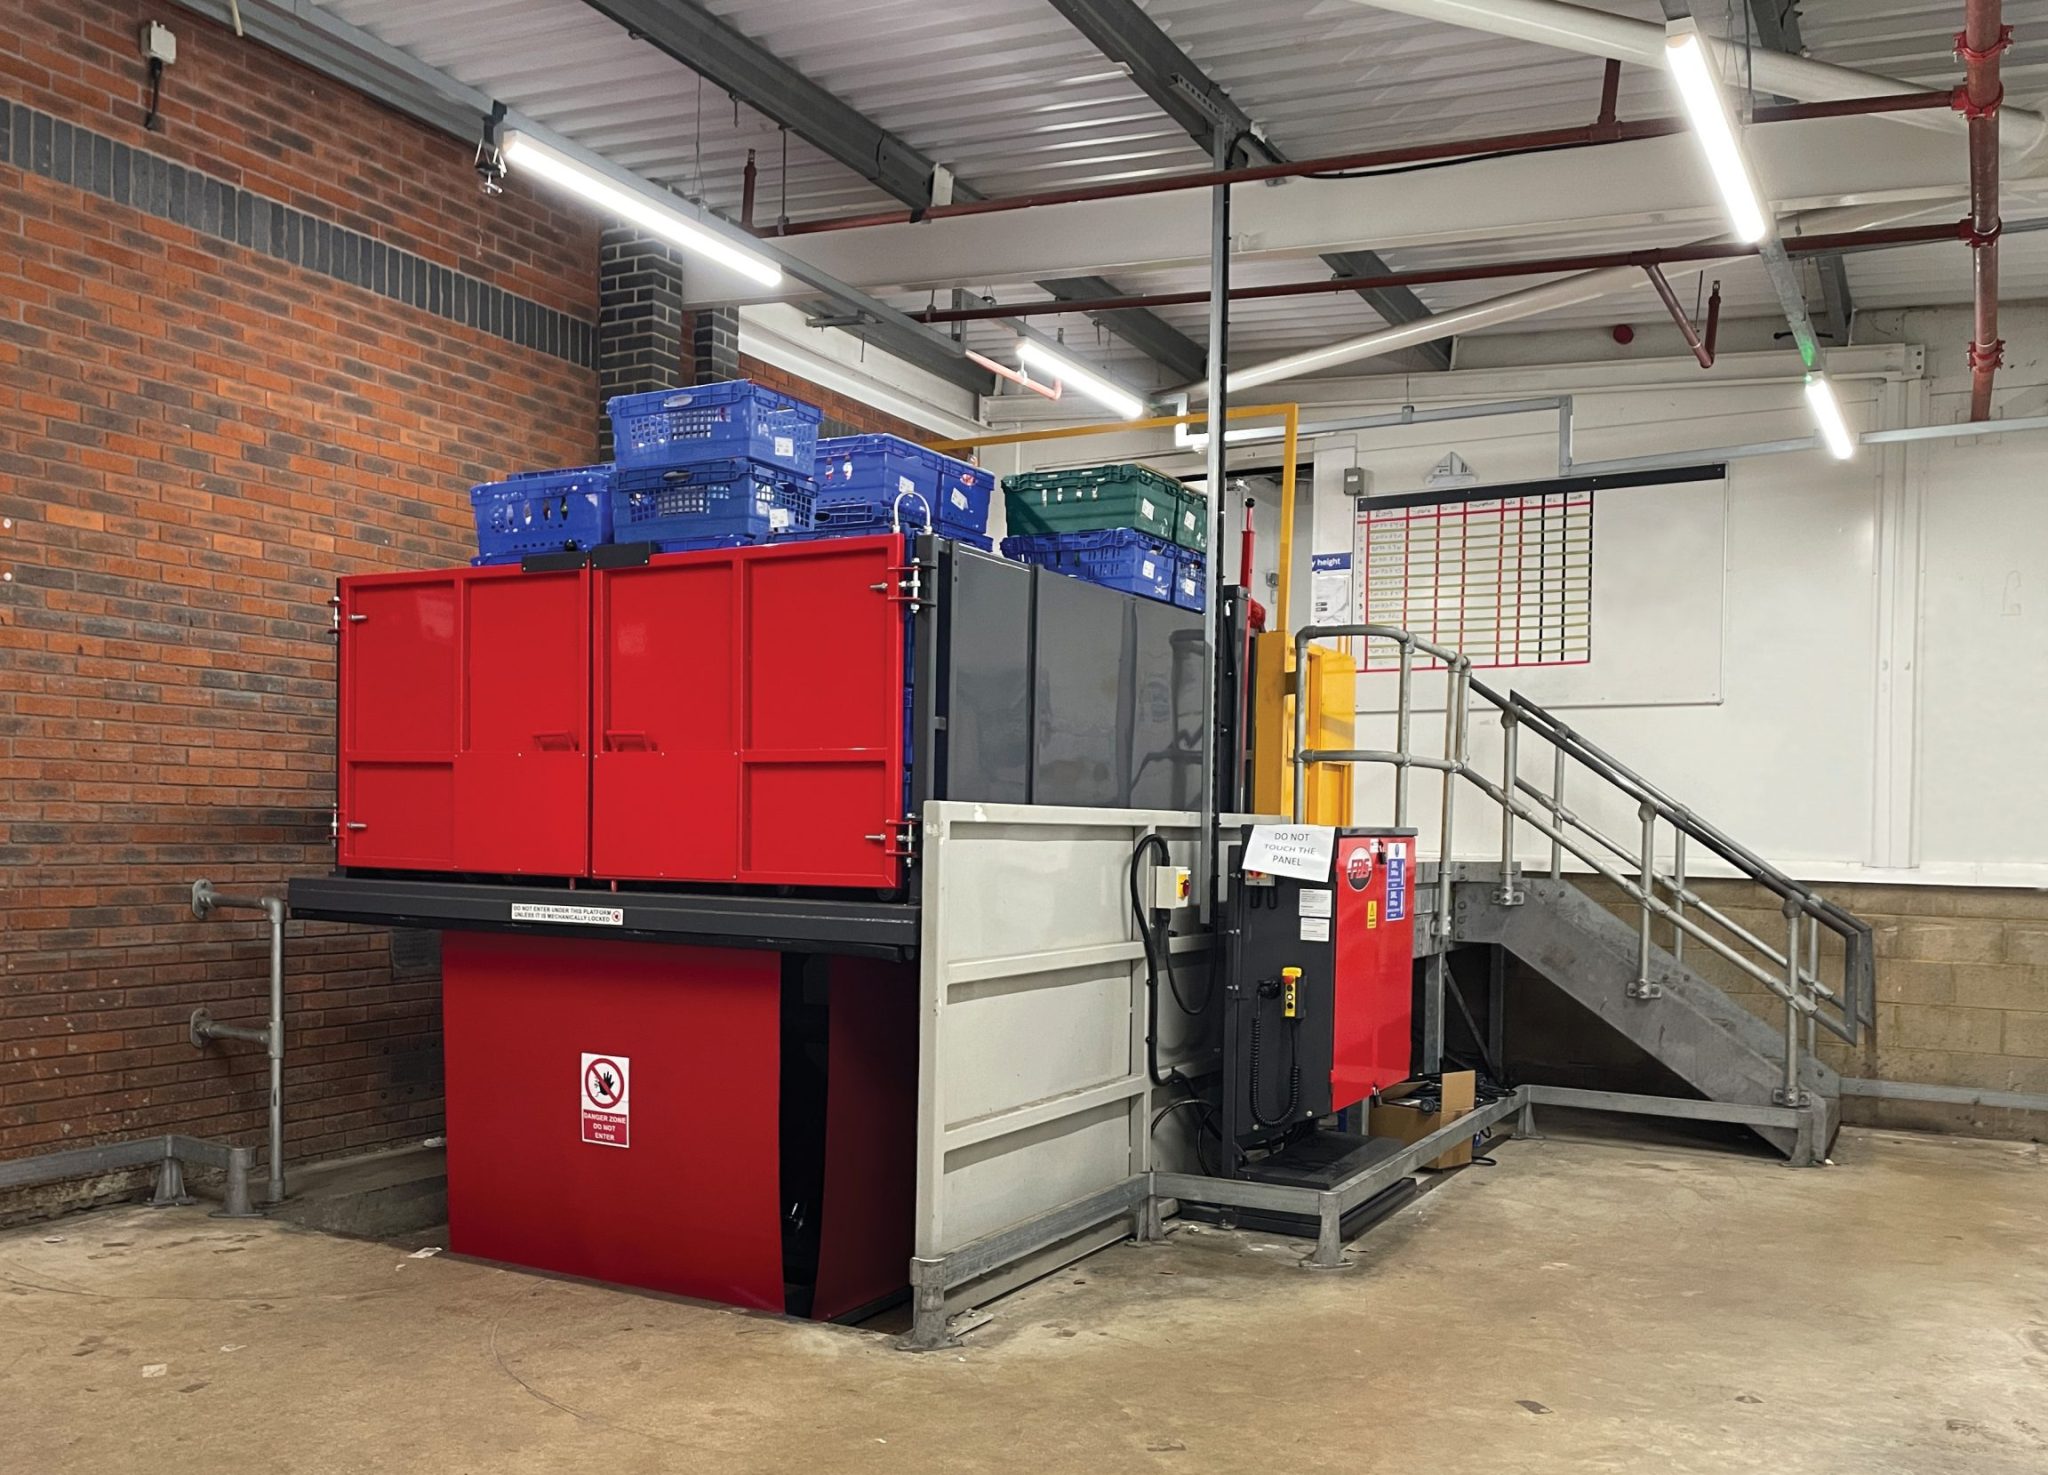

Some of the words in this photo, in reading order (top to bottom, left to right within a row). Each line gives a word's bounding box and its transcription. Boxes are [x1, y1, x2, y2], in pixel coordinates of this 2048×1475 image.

[1317, 558, 1341, 567] height
[1274, 832, 1289, 841] DO
[1290, 833, 1311, 841] NOT
[1264, 843, 1296, 853] TOUCH
[1298, 846, 1317, 855] THE
[1272, 854, 1303, 867] PANEL
[547, 913, 587, 921] MECHANICALLY
[584, 1112, 608, 1121] DANGER
[608, 1115, 626, 1124] ZONE
[603, 1124, 616, 1132] NOT
[594, 1132, 615, 1141] ENTER
